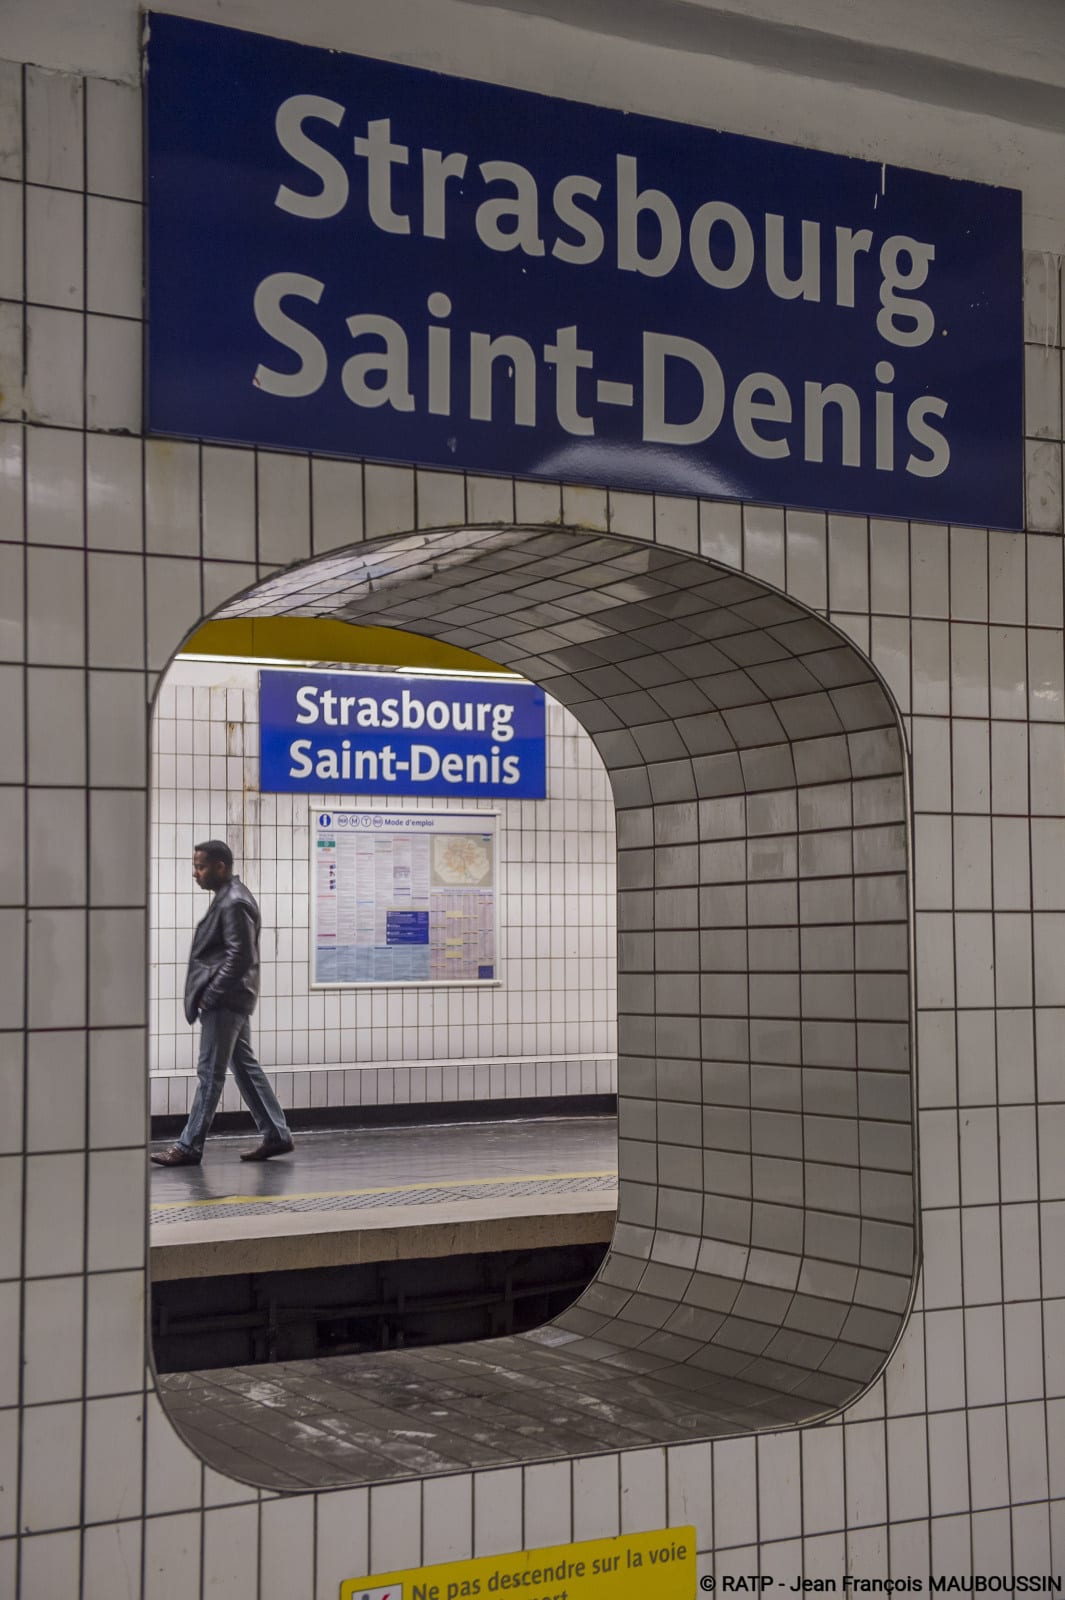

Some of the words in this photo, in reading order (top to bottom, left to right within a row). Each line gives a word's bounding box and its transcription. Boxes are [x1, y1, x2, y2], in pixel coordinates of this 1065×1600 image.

[274, 93, 936, 347] Strasbourg
[252, 271, 951, 479] Saint-Denis
[296, 686, 514, 742] Strasbourg
[289, 739, 520, 785] Saint-Denis
[384, 818, 403, 826] Mode
[405, 818, 434, 827] d'emploi
[413, 1583, 439, 1600] Ne
[447, 1578, 481, 1600] pas
[487, 1560, 586, 1592] descendre
[592, 1555, 620, 1574] sur
[627, 1549, 643, 1569] la
[649, 1542, 687, 1564] voie
